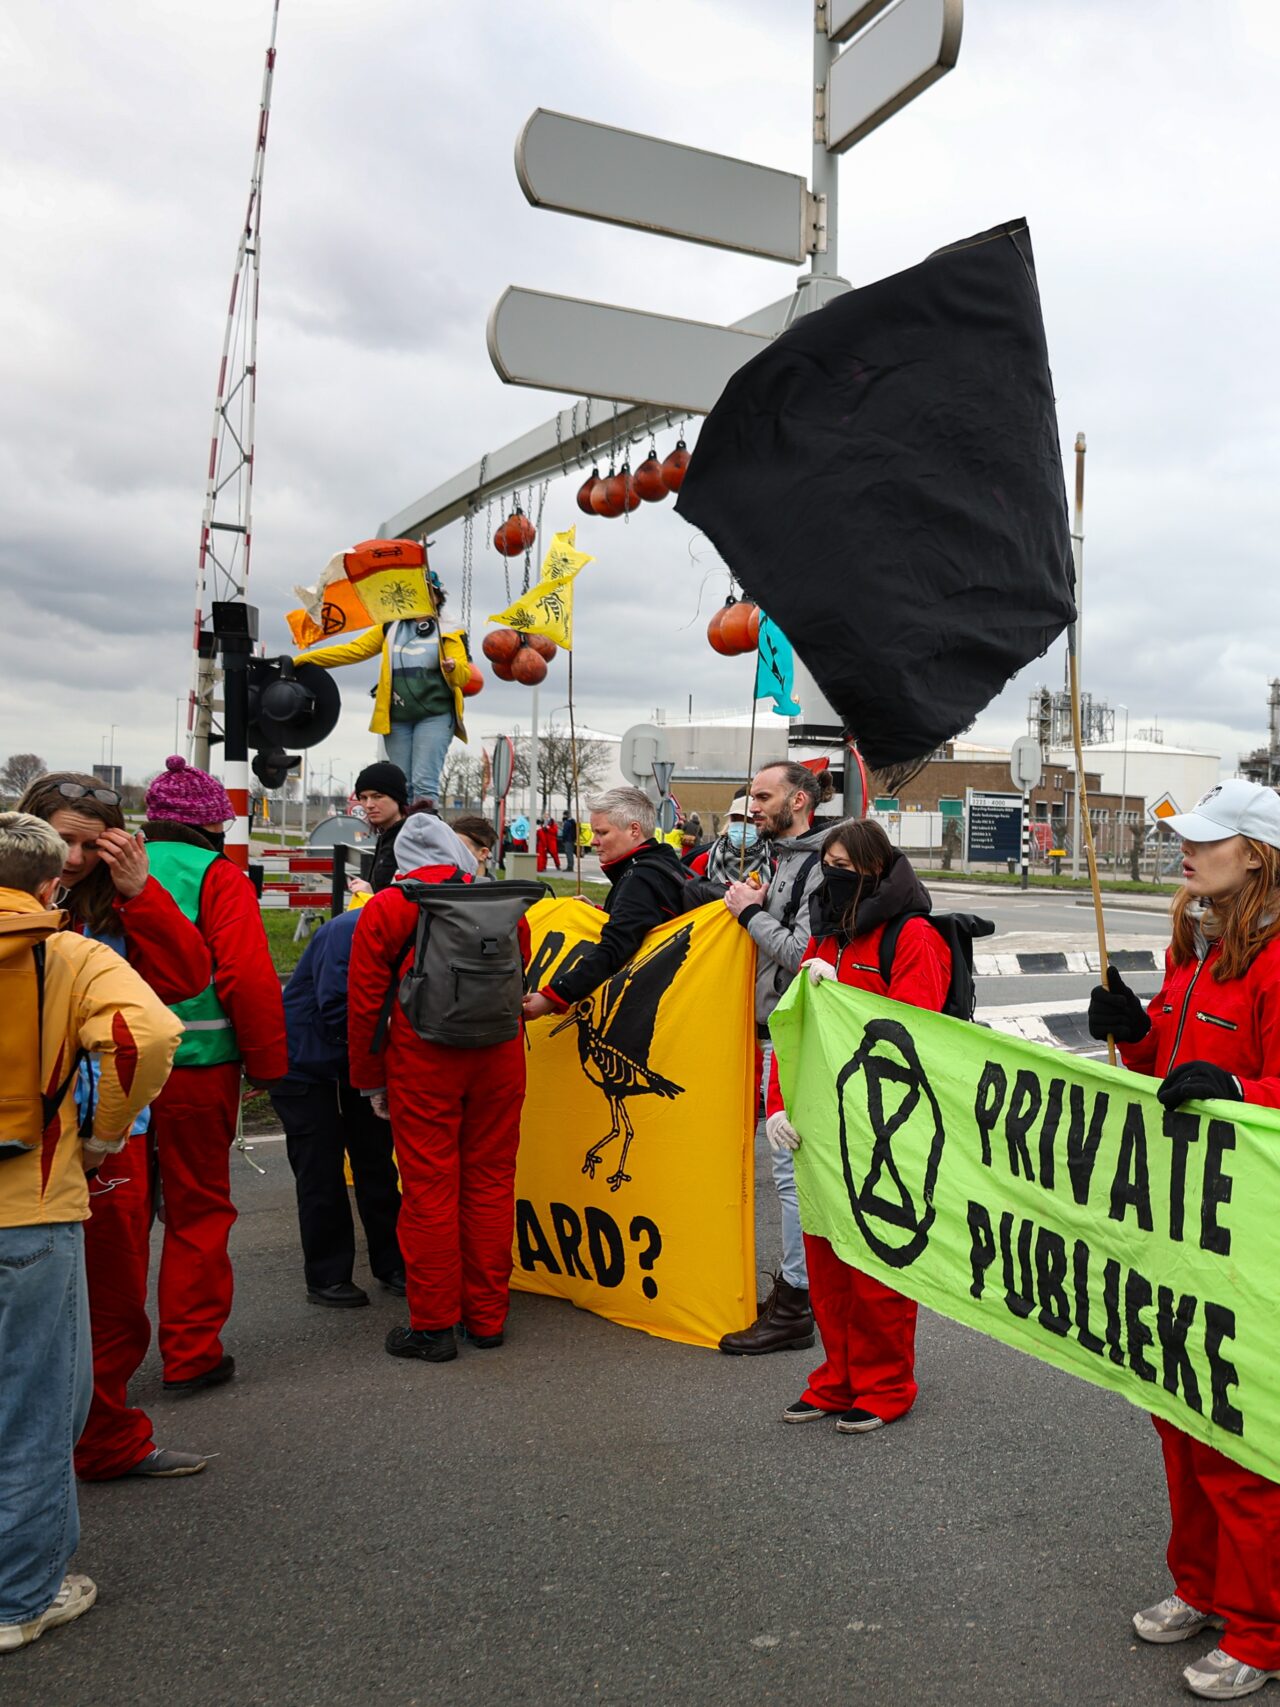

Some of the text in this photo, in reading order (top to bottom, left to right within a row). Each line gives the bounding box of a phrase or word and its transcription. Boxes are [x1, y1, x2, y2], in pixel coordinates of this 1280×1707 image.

[352, 809, 365, 817] 50
[974, 1060, 1236, 1256] PRIVATE
[966, 1200, 1244, 1437] PUBLIEKE
